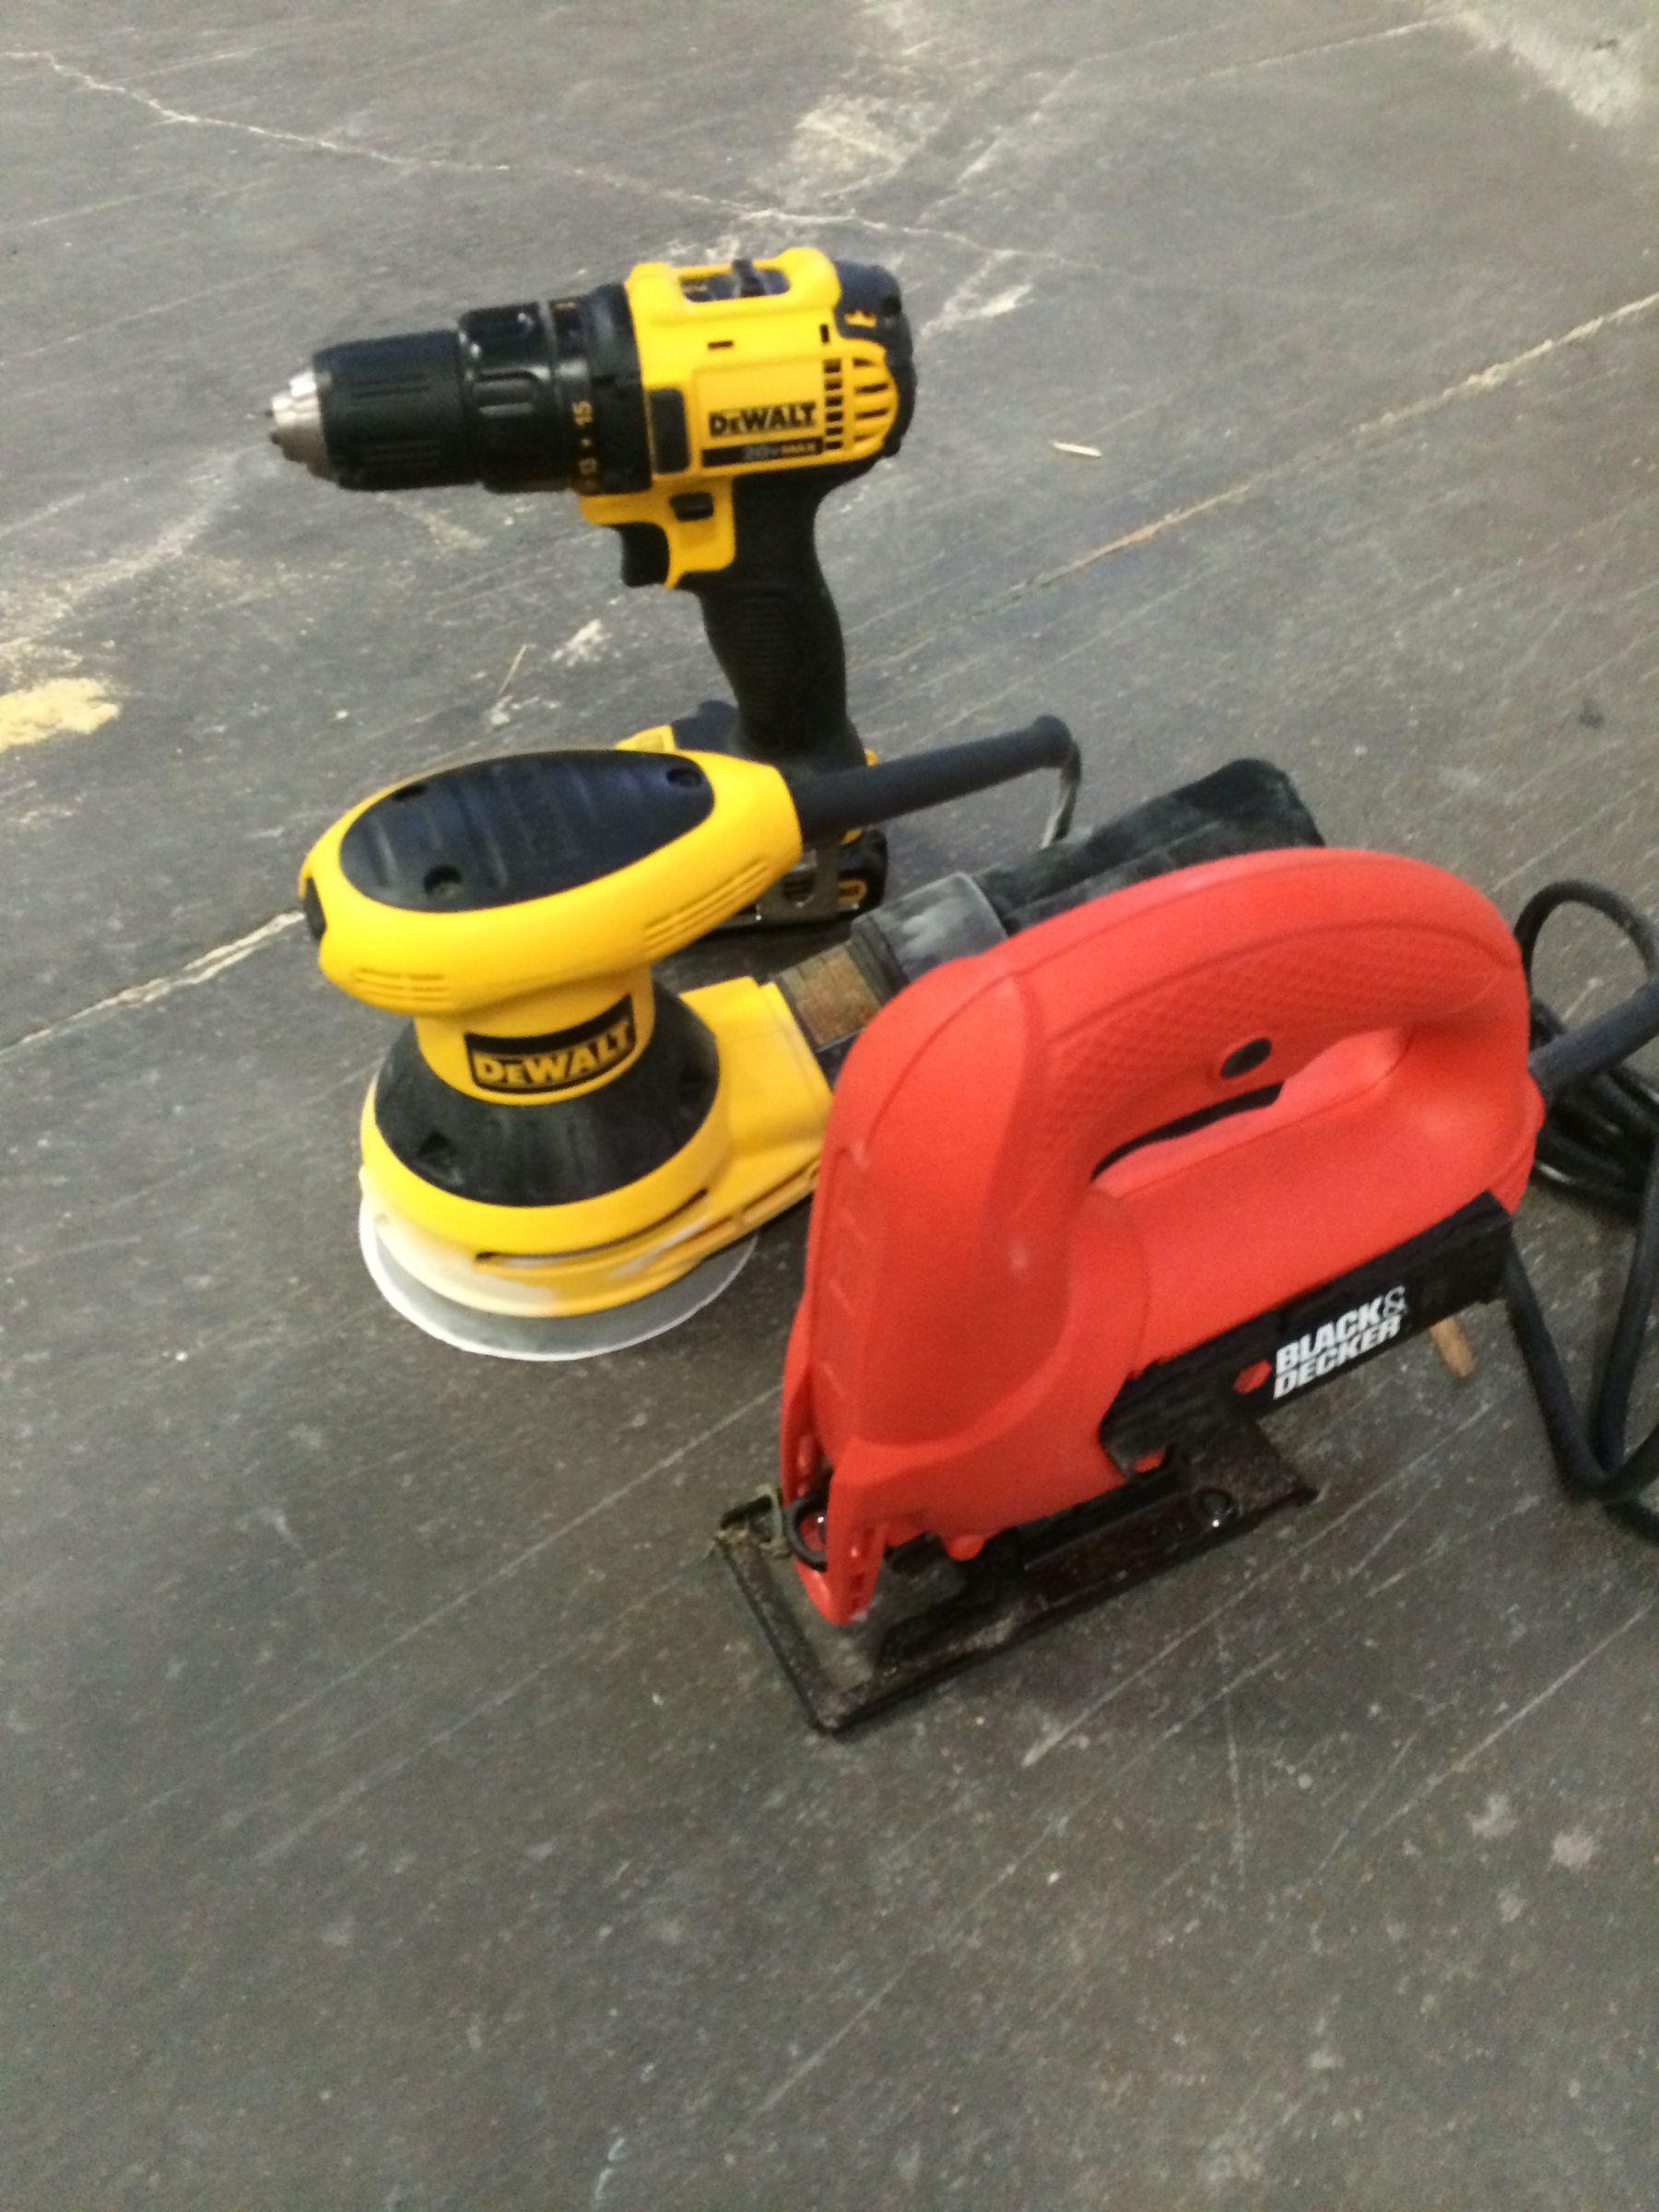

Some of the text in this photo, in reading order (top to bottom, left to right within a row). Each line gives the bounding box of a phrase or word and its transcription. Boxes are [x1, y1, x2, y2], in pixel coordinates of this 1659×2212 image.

[1273, 1315, 1402, 1400] DECKER
[1275, 1286, 1408, 1376] BLACK &
